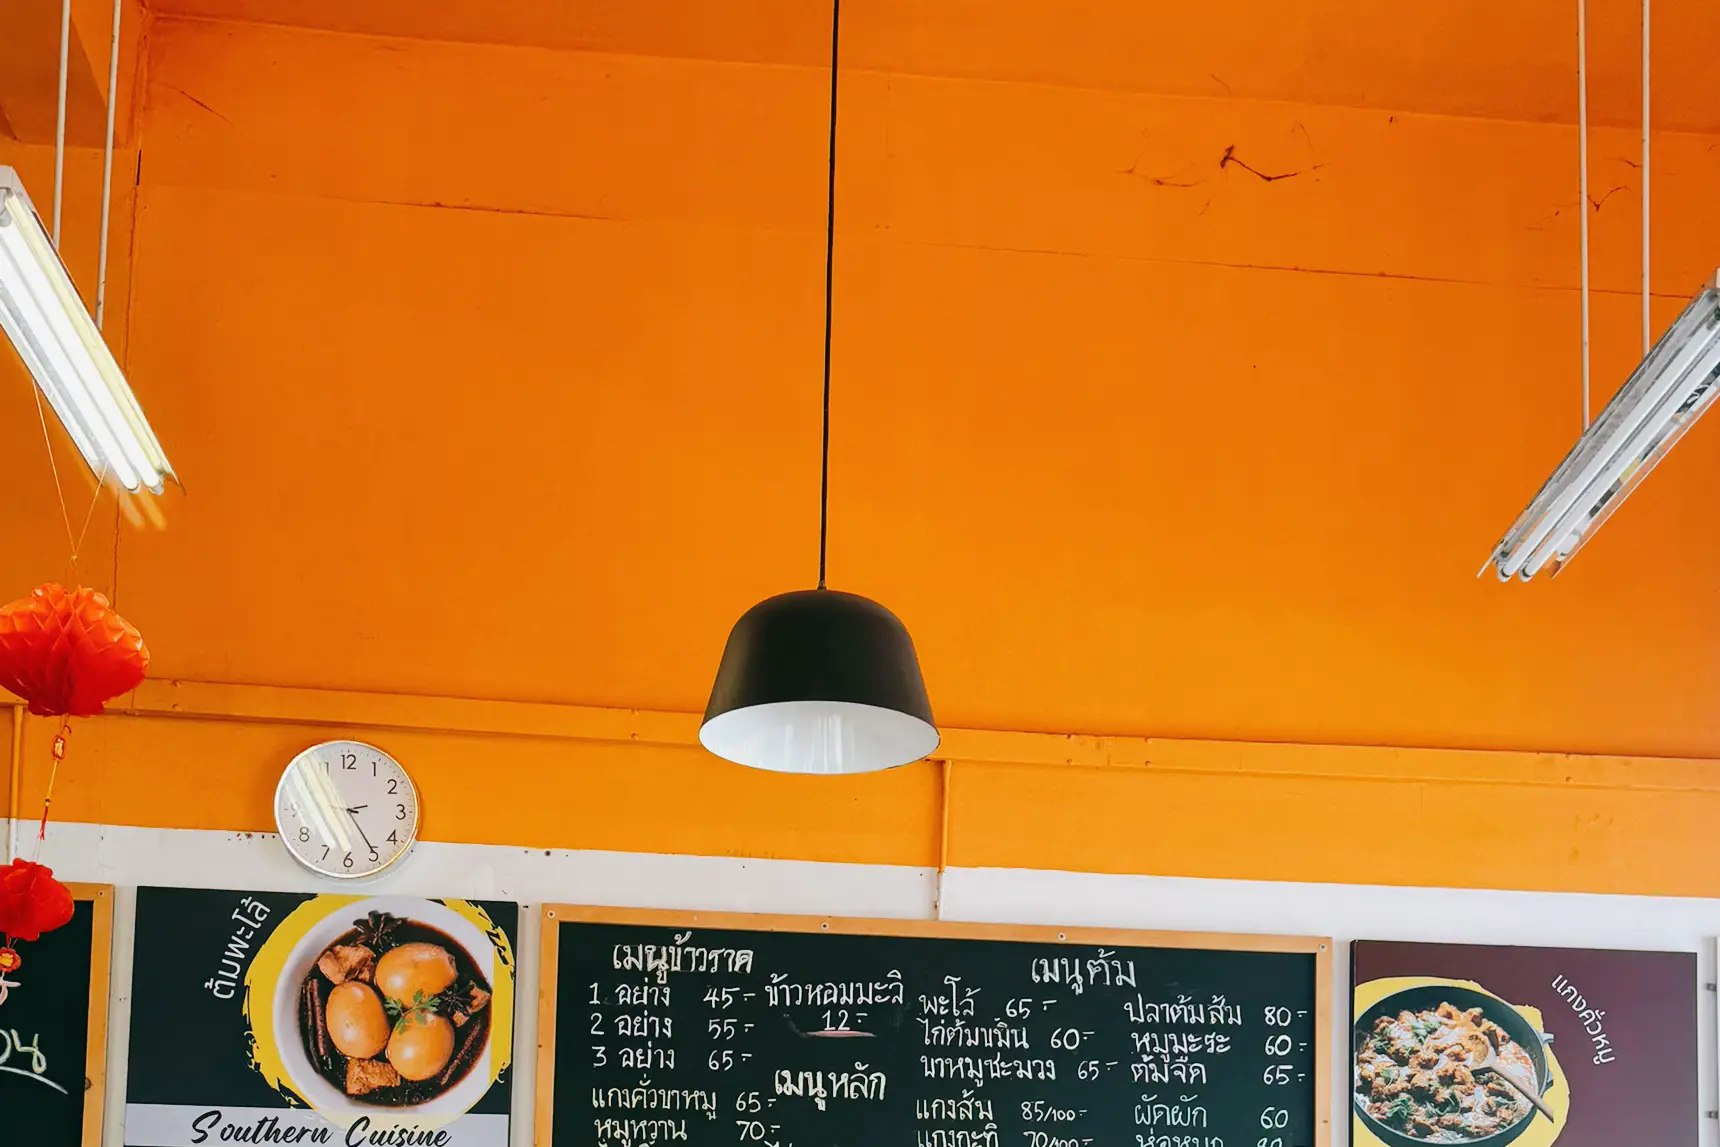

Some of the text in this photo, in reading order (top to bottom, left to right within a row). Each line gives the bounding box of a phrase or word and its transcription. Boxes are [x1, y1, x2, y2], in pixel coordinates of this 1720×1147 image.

[341, 754, 357, 770] 12
[371, 762, 377, 777] 1
[387, 779, 398, 795] 2
[395, 804, 406, 820] 3
[299, 827, 310, 843] 8
[386, 830, 398, 845] 4
[322, 845, 331, 861] 7
[343, 851, 354, 868] 6
[368, 846, 379, 862] 5
[204, 896, 271, 999] ต้มพะโล้
[1032, 948, 1136, 995] เมนูต้ม
[589, 983, 600, 1004] 1
[615, 977, 670, 1006] อย่าง
[765, 970, 903, 1006] ข้าวหอมมะลิ
[919, 976, 981, 1016] พะโล้
[1124, 993, 1241, 1025] ปลาต้มส้ม
[1551, 974, 1616, 1065] แกงคั่วหมู
[591, 1013, 604, 1035] 2
[614, 1010, 672, 1038] อย่าง
[592, 1046, 606, 1067] 3
[619, 1041, 674, 1069] อย่าง
[1131, 1032, 1230, 1062] หมูมะระ
[775, 1062, 886, 1111] เมนูหลัก
[917, 1089, 993, 1120] แกงส้ม
[1135, 1094, 1288, 1129] ผัดผัก 60
[190, 1109, 335, 1147] Southern
